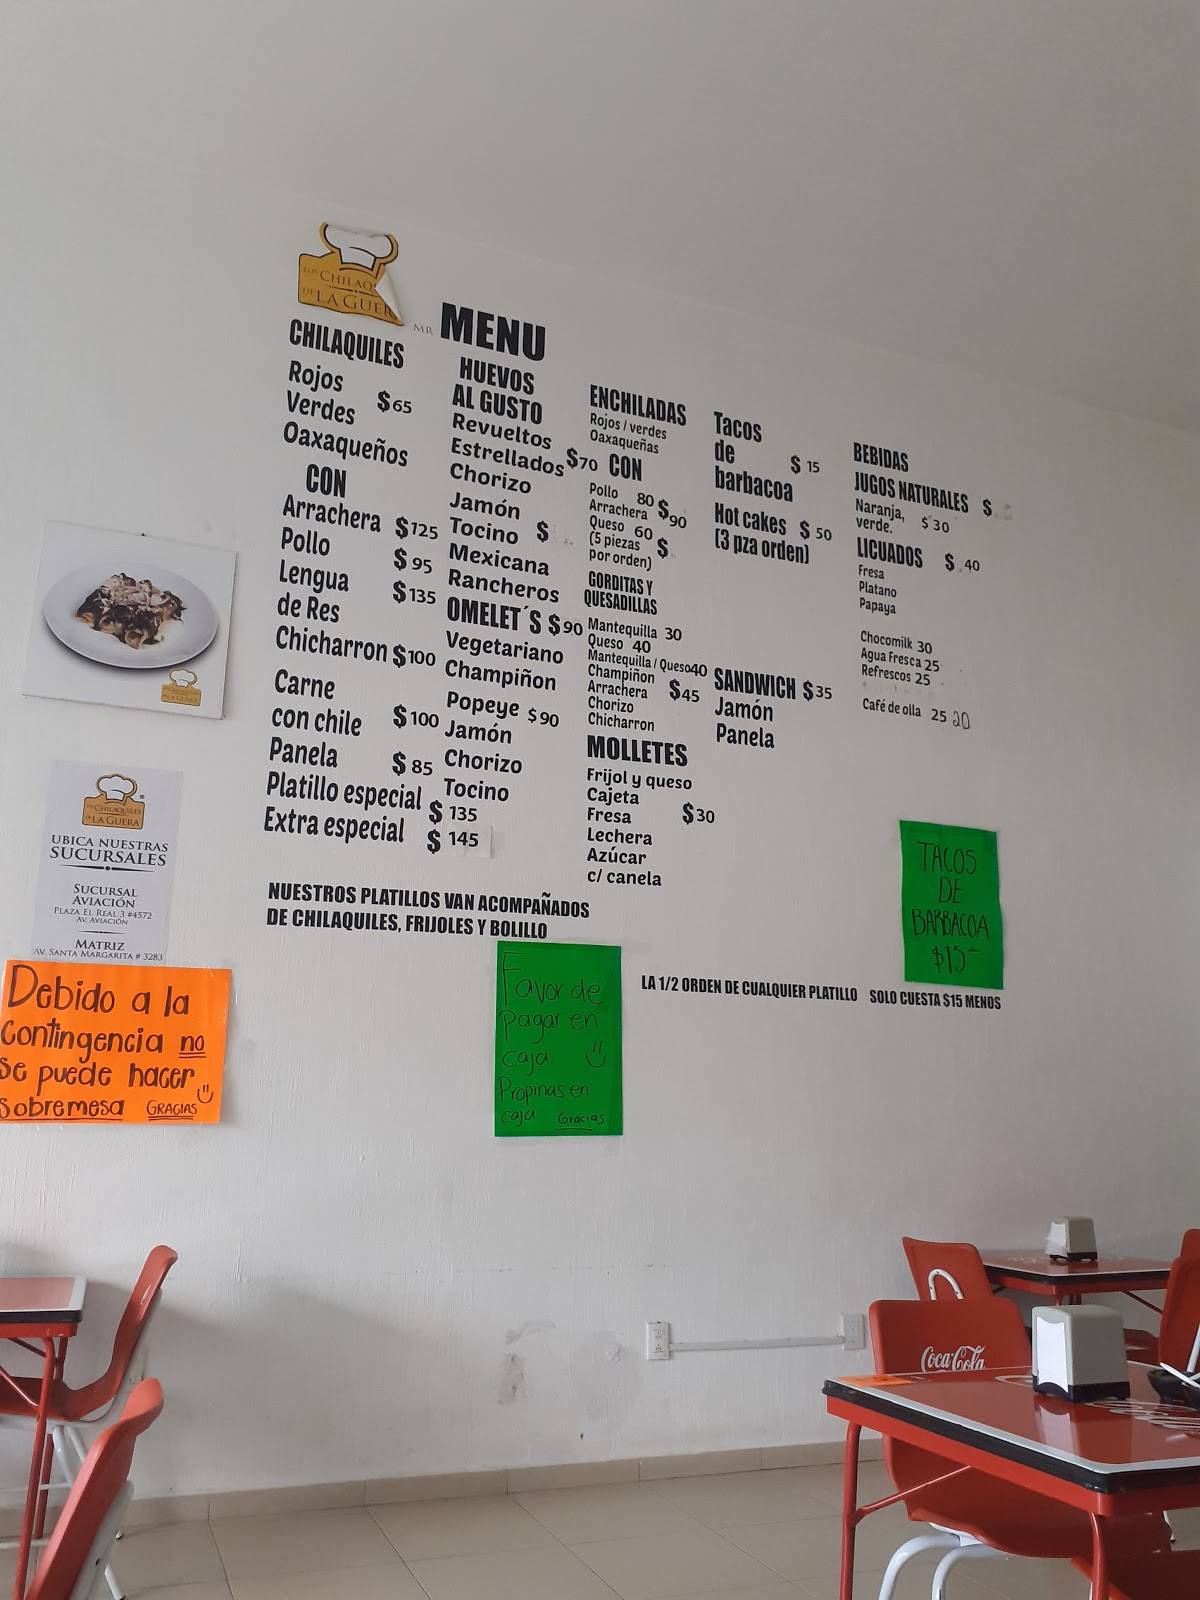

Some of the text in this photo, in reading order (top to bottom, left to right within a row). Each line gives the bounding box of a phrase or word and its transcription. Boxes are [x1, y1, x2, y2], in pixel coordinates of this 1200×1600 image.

[289, 318, 404, 370] CHILAQUILES
[440, 302, 546, 362] MENU
[288, 360, 344, 392] Rojos
[460, 356, 534, 396] HUEVOS
[286, 390, 356, 425] Verdes
[452, 383, 542, 425] AL GUSTO
[590, 385, 687, 426] ENCHILADAS
[453, 413, 552, 450] Revueltos
[590, 412, 667, 442] Rojos verdes
[714, 410, 762, 443] Tacos
[284, 421, 408, 467] Oaxaqueños
[590, 429, 659, 454] Oaxaqueñas
[714, 438, 735, 464] de
[451, 438, 565, 477] Estrellados
[609, 453, 642, 482] CON
[853, 442, 909, 472] BEBIDAS
[306, 464, 346, 498] CON
[450, 462, 532, 494] Chorizo
[590, 482, 618, 499] Pollo
[714, 465, 793, 502] barbacoa
[449, 492, 520, 520] Jamón
[854, 472, 968, 514] JUGOS NATURALES
[282, 494, 381, 533] Arrachera
[589, 498, 648, 520] Arrachera
[590, 514, 624, 532] Queso
[714, 502, 786, 536] Hot cakes
[856, 498, 904, 523] Naranja,
[450, 516, 518, 544] Tocino
[856, 517, 892, 534] verde.
[281, 526, 330, 556] Pollo
[604, 534, 640, 551] piezas
[733, 534, 810, 564] pza orden)
[856, 536, 923, 568] LICUADOS
[449, 542, 550, 576] Mexicana
[589, 548, 652, 572] por orden)
[858, 564, 884, 580] Fresa
[279, 558, 349, 594] Lengua
[448, 568, 560, 603] Rancheros
[588, 570, 644, 595] GORDITAS
[859, 580, 897, 598] Platano
[277, 592, 340, 623] de Res
[584, 588, 658, 616] QUESADILLAS
[860, 597, 896, 616] Papaya
[588, 616, 682, 642] Mantequilla 30
[588, 632, 651, 654] Queso 40
[860, 630, 932, 654] Chocomilk 30
[276, 625, 388, 662] Chicharron
[446, 630, 564, 664] Vegetariano
[588, 648, 652, 671] Mantequilla
[588, 663, 655, 684] Champiñon
[860, 647, 940, 672] Agua Fresca 25
[274, 668, 335, 700] Carne
[445, 659, 556, 691] Champiñon
[714, 667, 796, 700] SANDWICH
[862, 664, 930, 686] Refrescos 25
[446, 690, 520, 720] Popeye
[588, 680, 648, 702] Arrachera
[588, 696, 634, 714] Chorizo
[272, 708, 362, 736] con chile
[588, 712, 654, 732] Chicharron
[714, 696, 774, 722] Jamón
[862, 698, 947, 722] Café de olla 25
[444, 720, 512, 744] Jamón
[716, 722, 775, 749] Panela
[270, 736, 338, 768] Panela
[587, 734, 688, 767] MOLLETES
[266, 771, 422, 811] Platillo especial
[587, 768, 692, 790] Frijol queso
[587, 786, 640, 806] Cajeta
[264, 806, 404, 844] Extra especial
[587, 806, 632, 824] Fresa
[51, 835, 168, 852] UBICA NUESTRAS
[587, 826, 652, 846] Lechera
[50, 846, 167, 867] SUCURSALES
[586, 846, 646, 865] Azúcar
[918, 841, 978, 875] TACOS
[74, 883, 137, 897] SUCURSAL
[606, 870, 662, 886] canela
[54, 907, 79, 916] PLAZA
[97, 909, 117, 917] REAL
[72, 895, 135, 908] AVIACIÓN
[268, 882, 590, 918] NUESTROS PLATILLOS VAN ACOMPAÑADOS
[90, 917, 128, 925] AVIACIÓN
[266, 908, 547, 939] DE CHILAQUILES, FRIJOLES Y BOLILLO
[912, 908, 990, 939] BARBACOA
[50, 948, 163, 961] SANTA MARGARITA 3283
[75, 939, 125, 951] MATRIZ
[8, 964, 189, 1017] Debido a la
[502, 951, 602, 1006] Favor de
[641, 975, 858, 1002] LA 1/2 ORDEN DE CUALQUIER PLATILLO
[870, 989, 1002, 1010] SOLO CUESTA $15 MENOS
[570, 1013, 598, 1031] en
[180, 1035, 204, 1052] no
[37, 1063, 195, 1096] puede hacer
